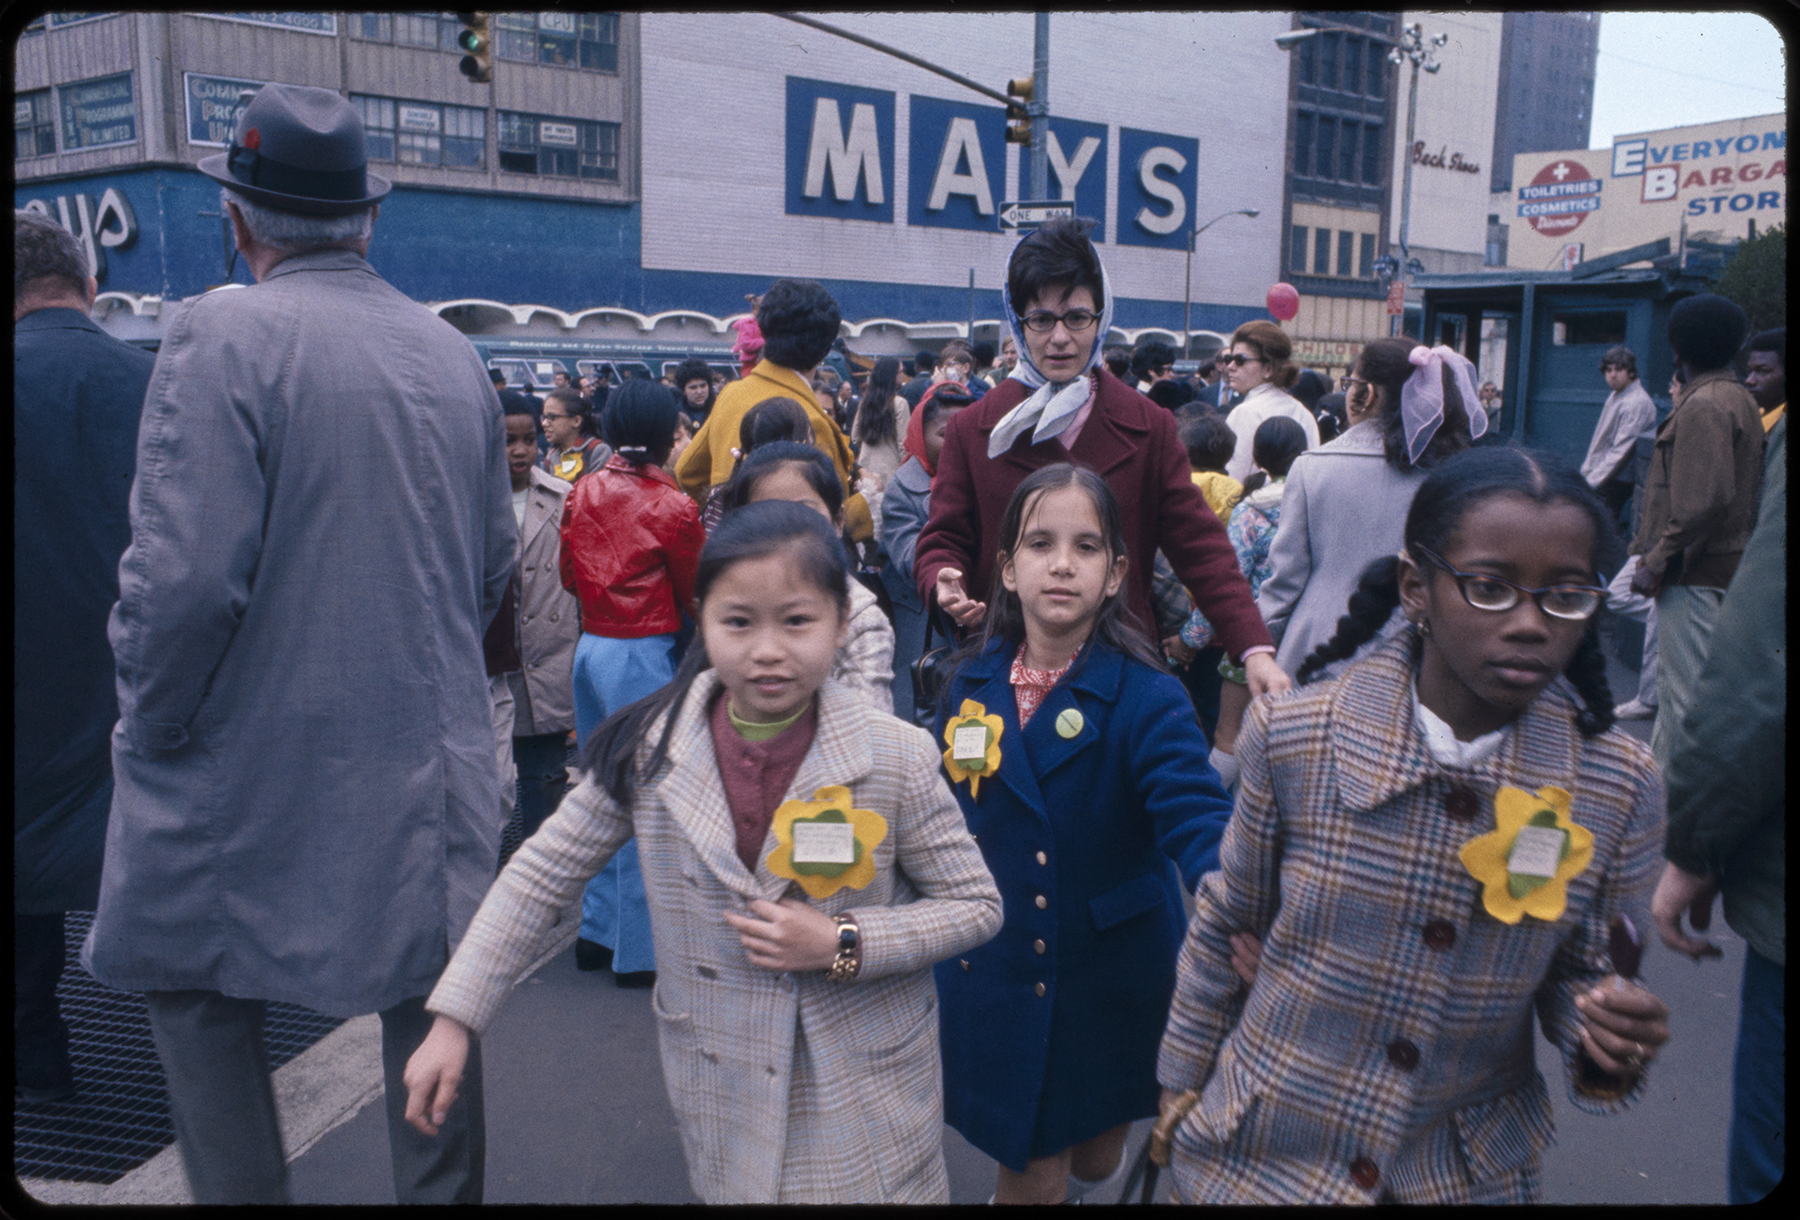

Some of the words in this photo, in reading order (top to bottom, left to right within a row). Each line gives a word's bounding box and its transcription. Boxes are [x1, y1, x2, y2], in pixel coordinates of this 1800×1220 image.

[803, 97, 1188, 235] MAYS
[1413, 140, 1446, 169] Beck
[1522, 181, 1599, 199] TOILETRIES
[1521, 197, 1598, 216] COSMETICS
[1687, 190, 1786, 217] STOR
[1009, 210, 1032, 221] ONE
